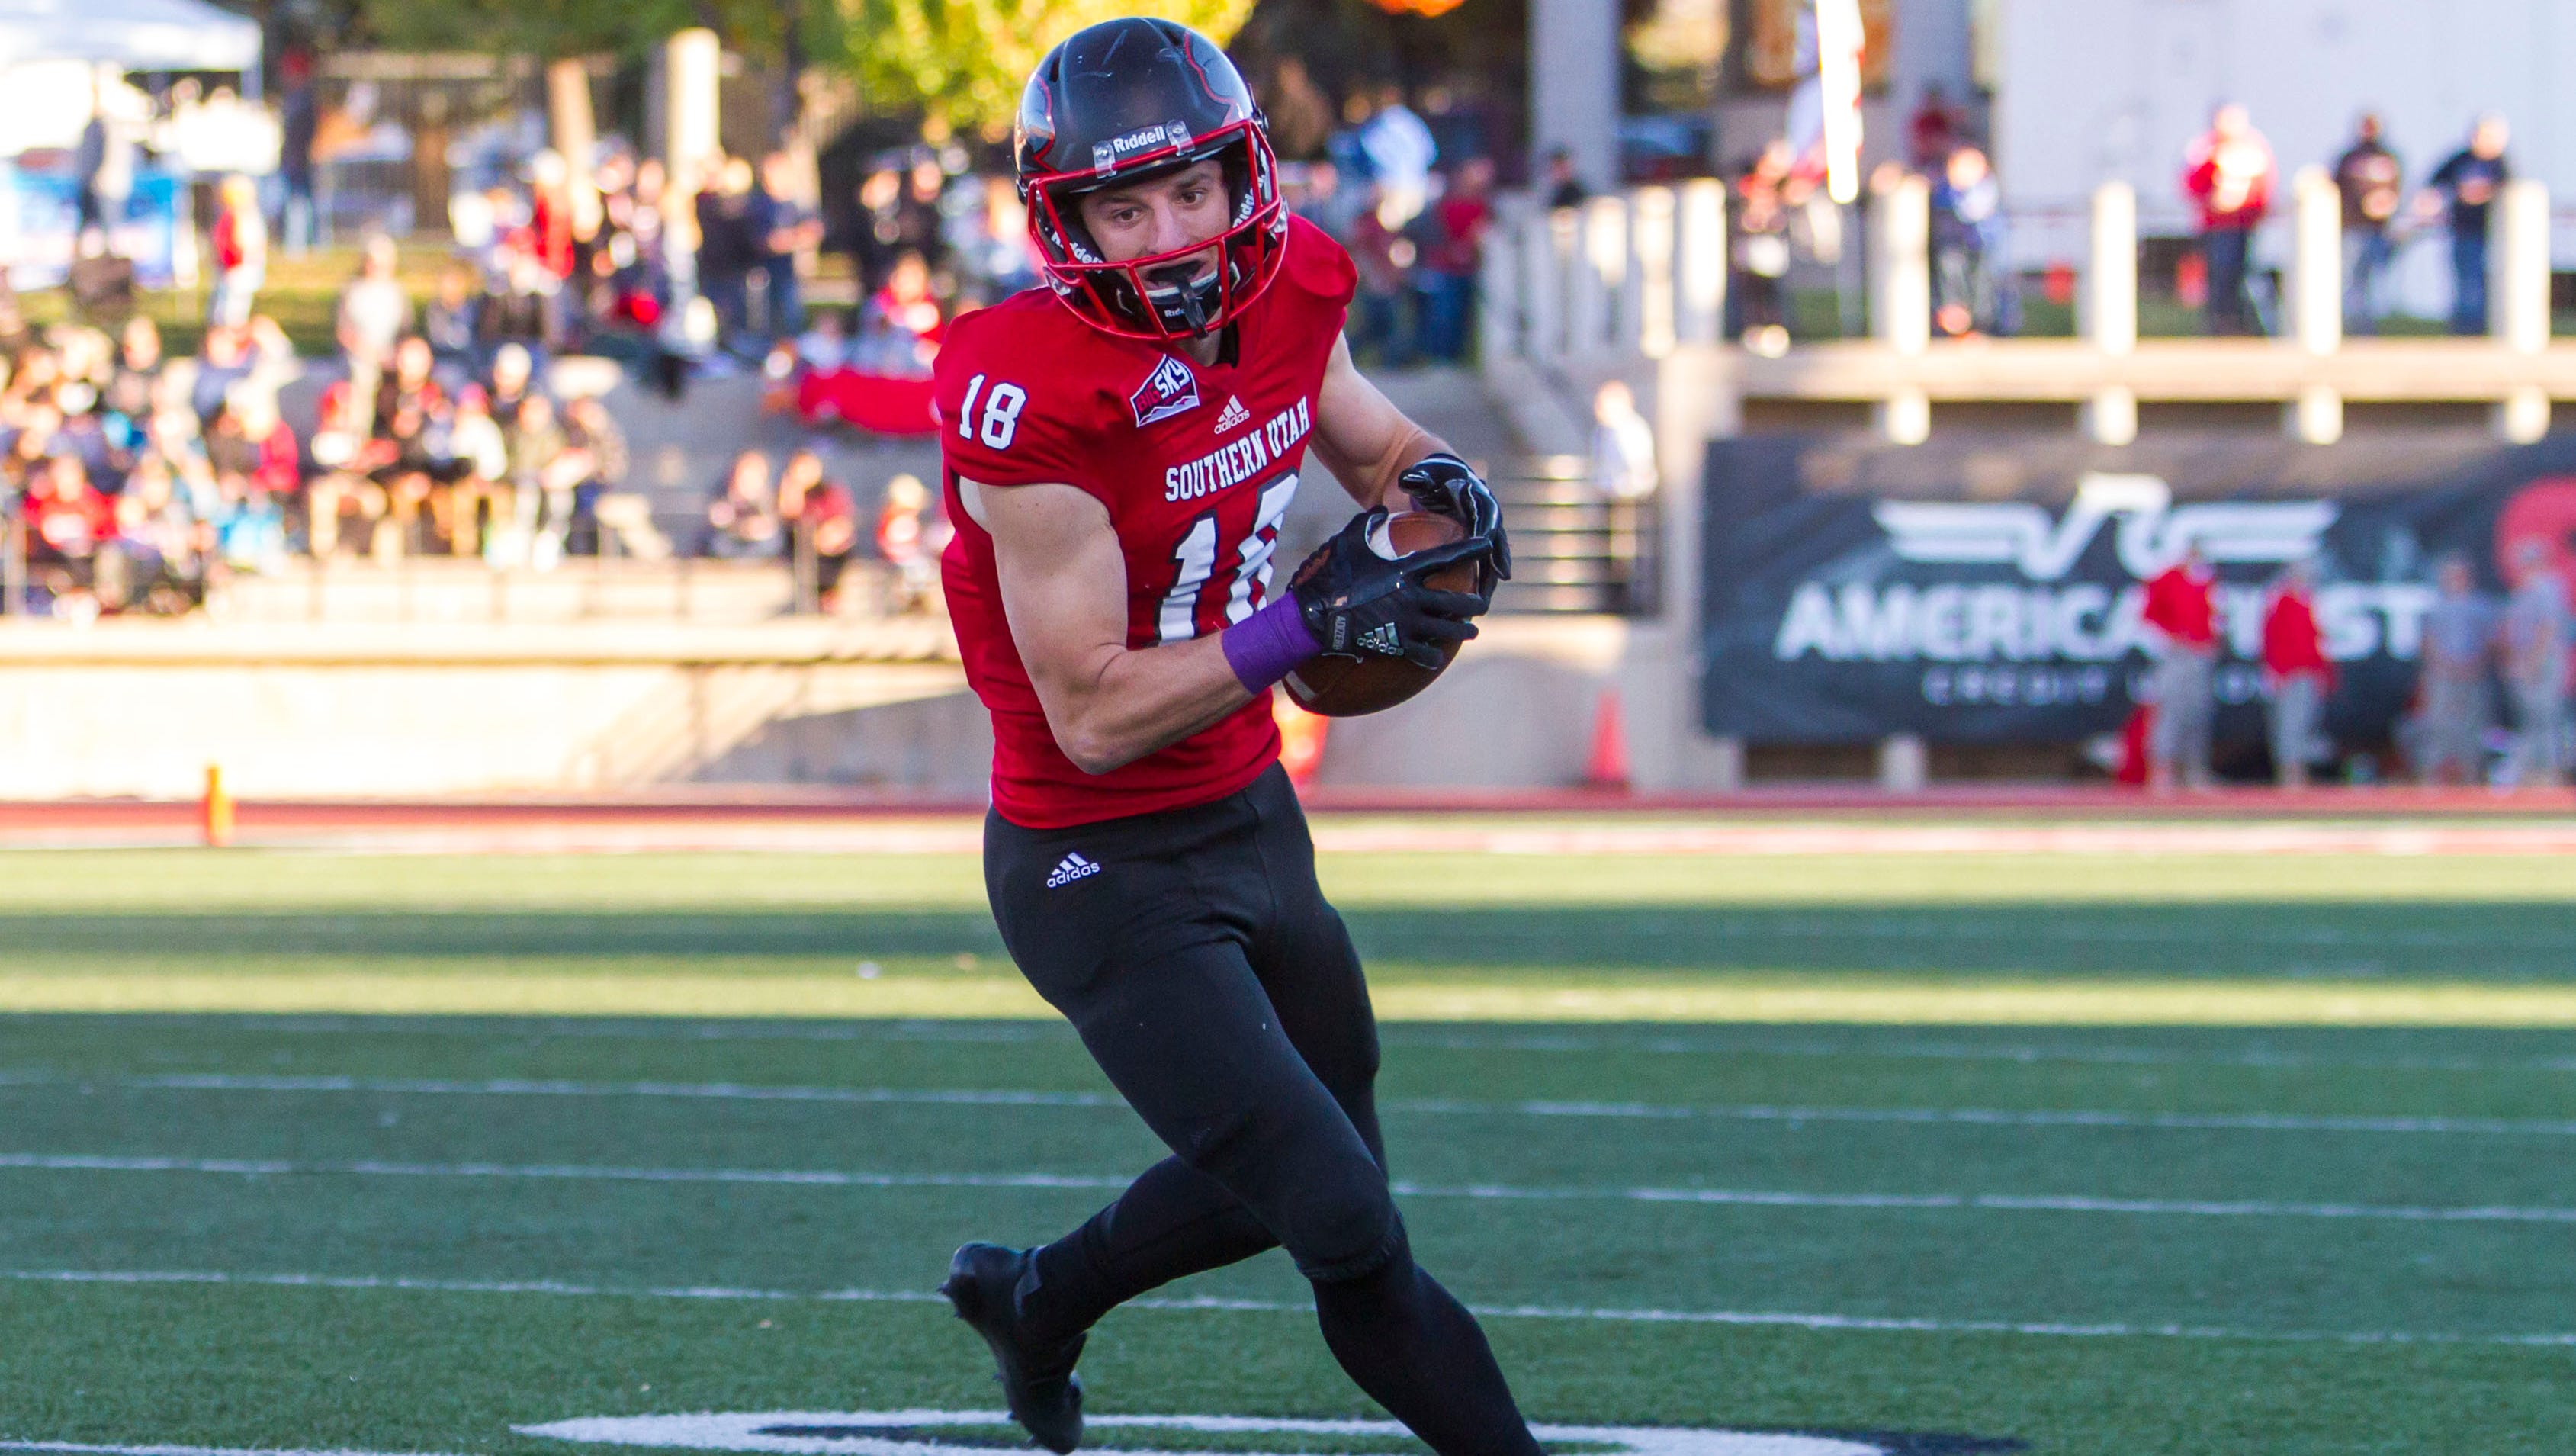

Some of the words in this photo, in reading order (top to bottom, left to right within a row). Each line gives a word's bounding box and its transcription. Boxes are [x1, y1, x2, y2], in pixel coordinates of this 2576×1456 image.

[1113, 126, 1166, 153] Riddell
[1135, 382, 1161, 413] BIG
[1154, 359, 1191, 400] SKY
[959, 374, 1027, 451] 18
[1214, 409, 1251, 435] adidas
[1164, 428, 1267, 502] SOUTHERN
[1266, 394, 1311, 458] UTAH
[1775, 582, 2164, 662] AMERICA
[2208, 582, 2439, 662] IST
[1357, 637, 1405, 656] adidas
[1046, 862, 1100, 888] adidas
